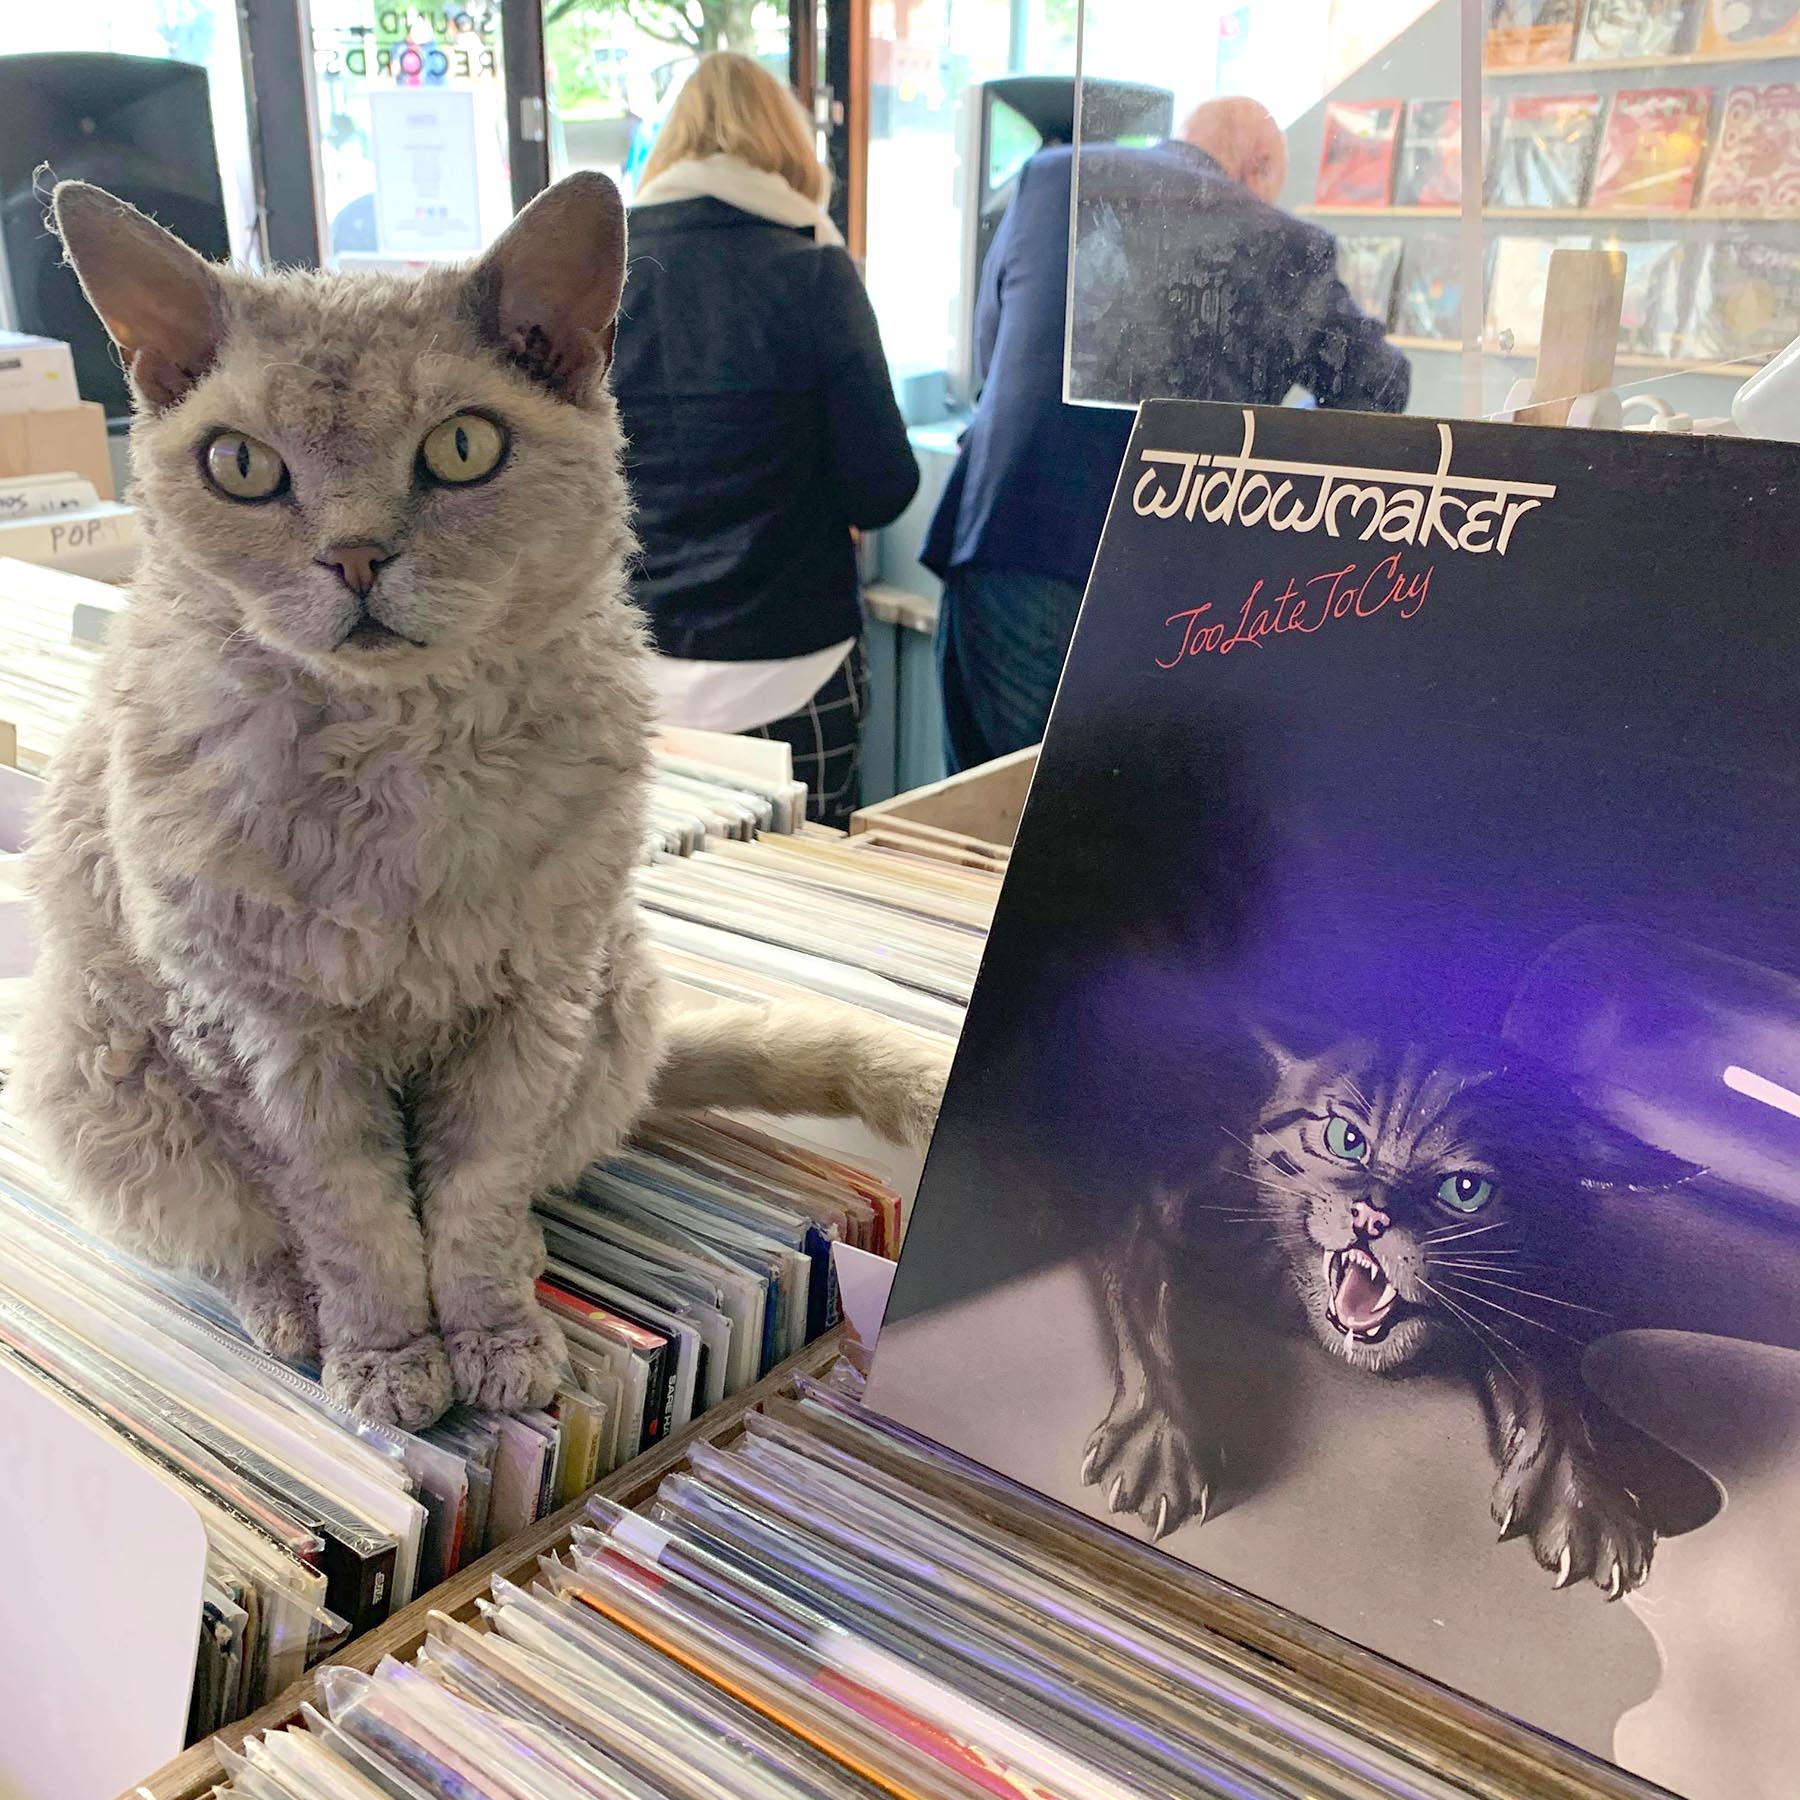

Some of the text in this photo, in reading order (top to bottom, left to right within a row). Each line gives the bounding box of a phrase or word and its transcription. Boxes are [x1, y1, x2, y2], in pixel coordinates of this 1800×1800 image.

[1155, 552, 1434, 668] Too Late To Cry
